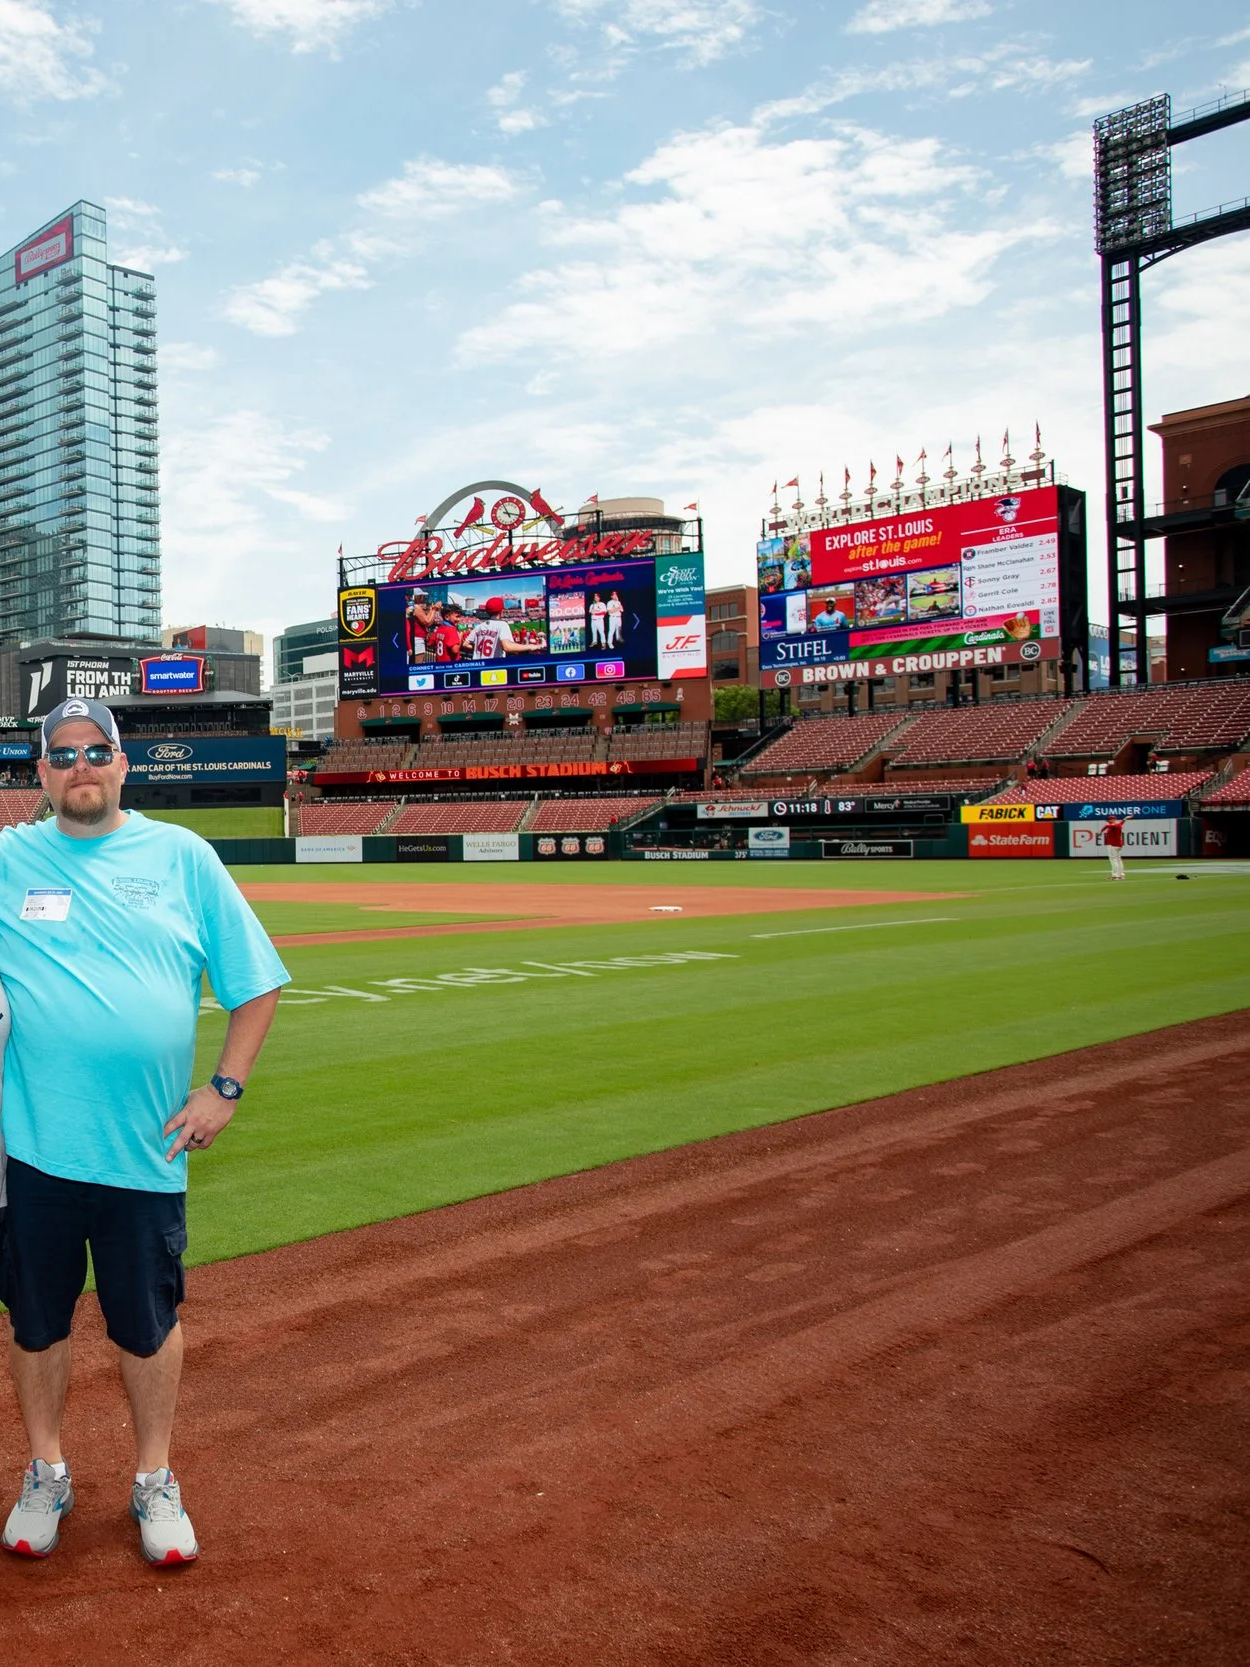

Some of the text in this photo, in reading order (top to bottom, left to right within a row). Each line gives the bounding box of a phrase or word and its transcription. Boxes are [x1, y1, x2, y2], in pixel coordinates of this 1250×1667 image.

[786, 473, 1023, 531] WORLD CHAMPIONS
[825, 519, 933, 551] EXPLORE ST. LOUIS
[992, 533, 1024, 542] LEADERS
[848, 531, 942, 560] after the game!
[977, 538, 1056, 556] Framber Valdez 2.49
[378, 531, 653, 583] Budweiser
[997, 557, 1034, 566] McClanahan
[1002, 574, 1020, 582] Gray
[347, 605, 371, 614] FANS'
[1007, 600, 1034, 609] Eovaldi
[347, 613, 369, 621] HEARTS
[964, 631, 1005, 645] Cardinals
[437, 641, 444, 656] 8
[477, 639, 493, 657] 46
[776, 639, 831, 661] STIFEL
[161, 653, 182, 661] Coca-Cola
[81, 661, 109, 669] PHORM
[803, 662, 869, 683] BROWN
[875, 663, 887, 675] &
[892, 647, 1000, 673] CROUPPEN
[1024, 645, 1038, 656] BC
[67, 670, 132, 685] FROM TH
[150, 672, 194, 680] smartwater
[67, 685, 130, 698] LOU AND
[380, 690, 661, 717] 1 2 6 9 10 14 17 20 23 24 42 45 85
[3, 747, 28, 755] UNION
[155, 746, 185, 759] Ford
[148, 764, 163, 772] CAR
[165, 764, 175, 772] OF
[193, 763, 203, 771] ST.
[204, 762, 227, 771] LOUIS
[228, 761, 271, 770] CARDINALS
[390, 771, 439, 779] WELCOME
[466, 766, 521, 779] BUSCH
[527, 762, 607, 777] STADIUM
[148, 774, 192, 782] BuyFordNow.com
[718, 804, 762, 812] Schnucks
[790, 803, 817, 813] 11:18
[838, 801, 856, 811] 83°
[874, 802, 895, 811] Mercy
[979, 806, 1060, 819] FABICK CAT
[759, 832, 779, 840] Ford
[1073, 829, 1171, 848] PEICIENT
[399, 845, 447, 853] HeGetsUs.com
[645, 851, 708, 859] BUSCH STADIUM
[840, 843, 872, 855] Bally
